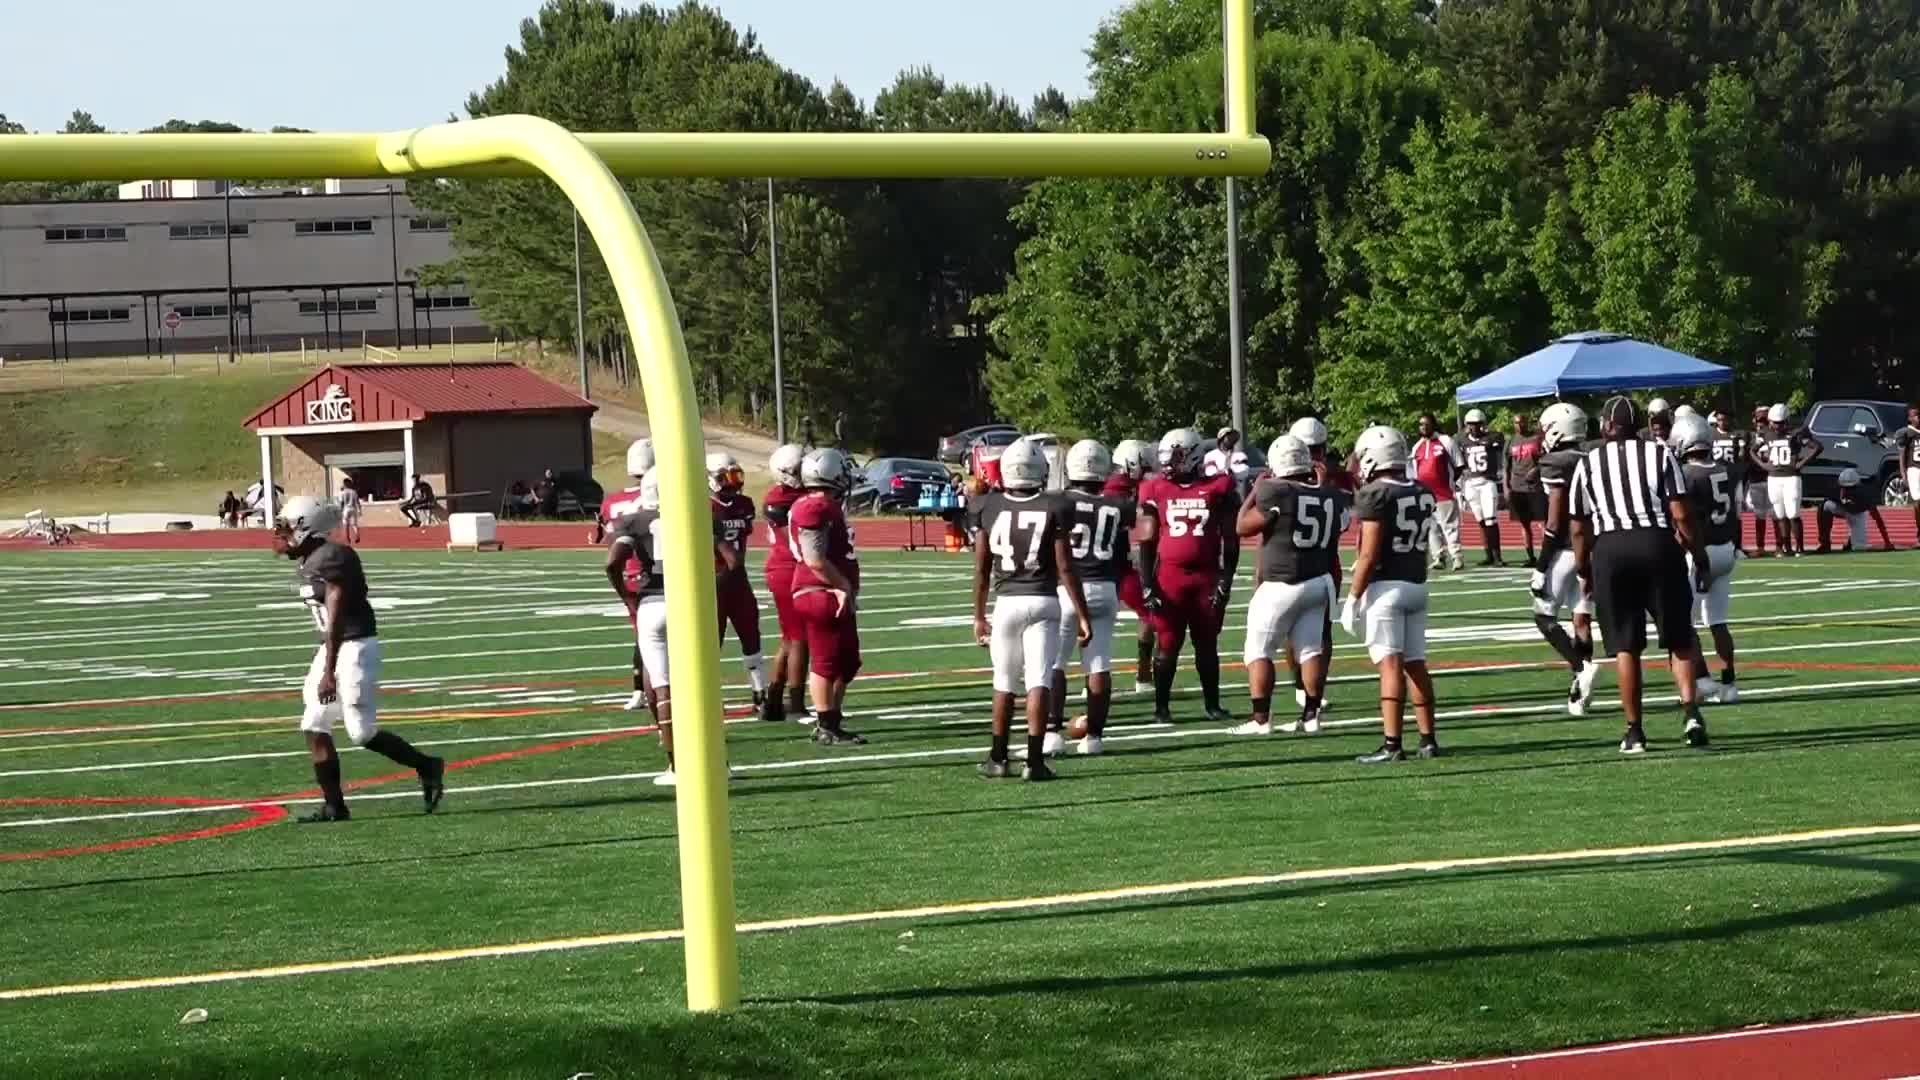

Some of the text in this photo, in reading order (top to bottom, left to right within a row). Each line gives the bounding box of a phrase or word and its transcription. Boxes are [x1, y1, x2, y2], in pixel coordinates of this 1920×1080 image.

[307, 400, 352, 423] KING
[1769, 446, 1791, 466] 40
[1166, 509, 1210, 537] 57
[1293, 495, 1334, 549] 51
[1392, 493, 1437, 552] 52
[1709, 472, 1731, 524] 5
[989, 511, 1047, 571] 47
[1069, 501, 1120, 560] 50
